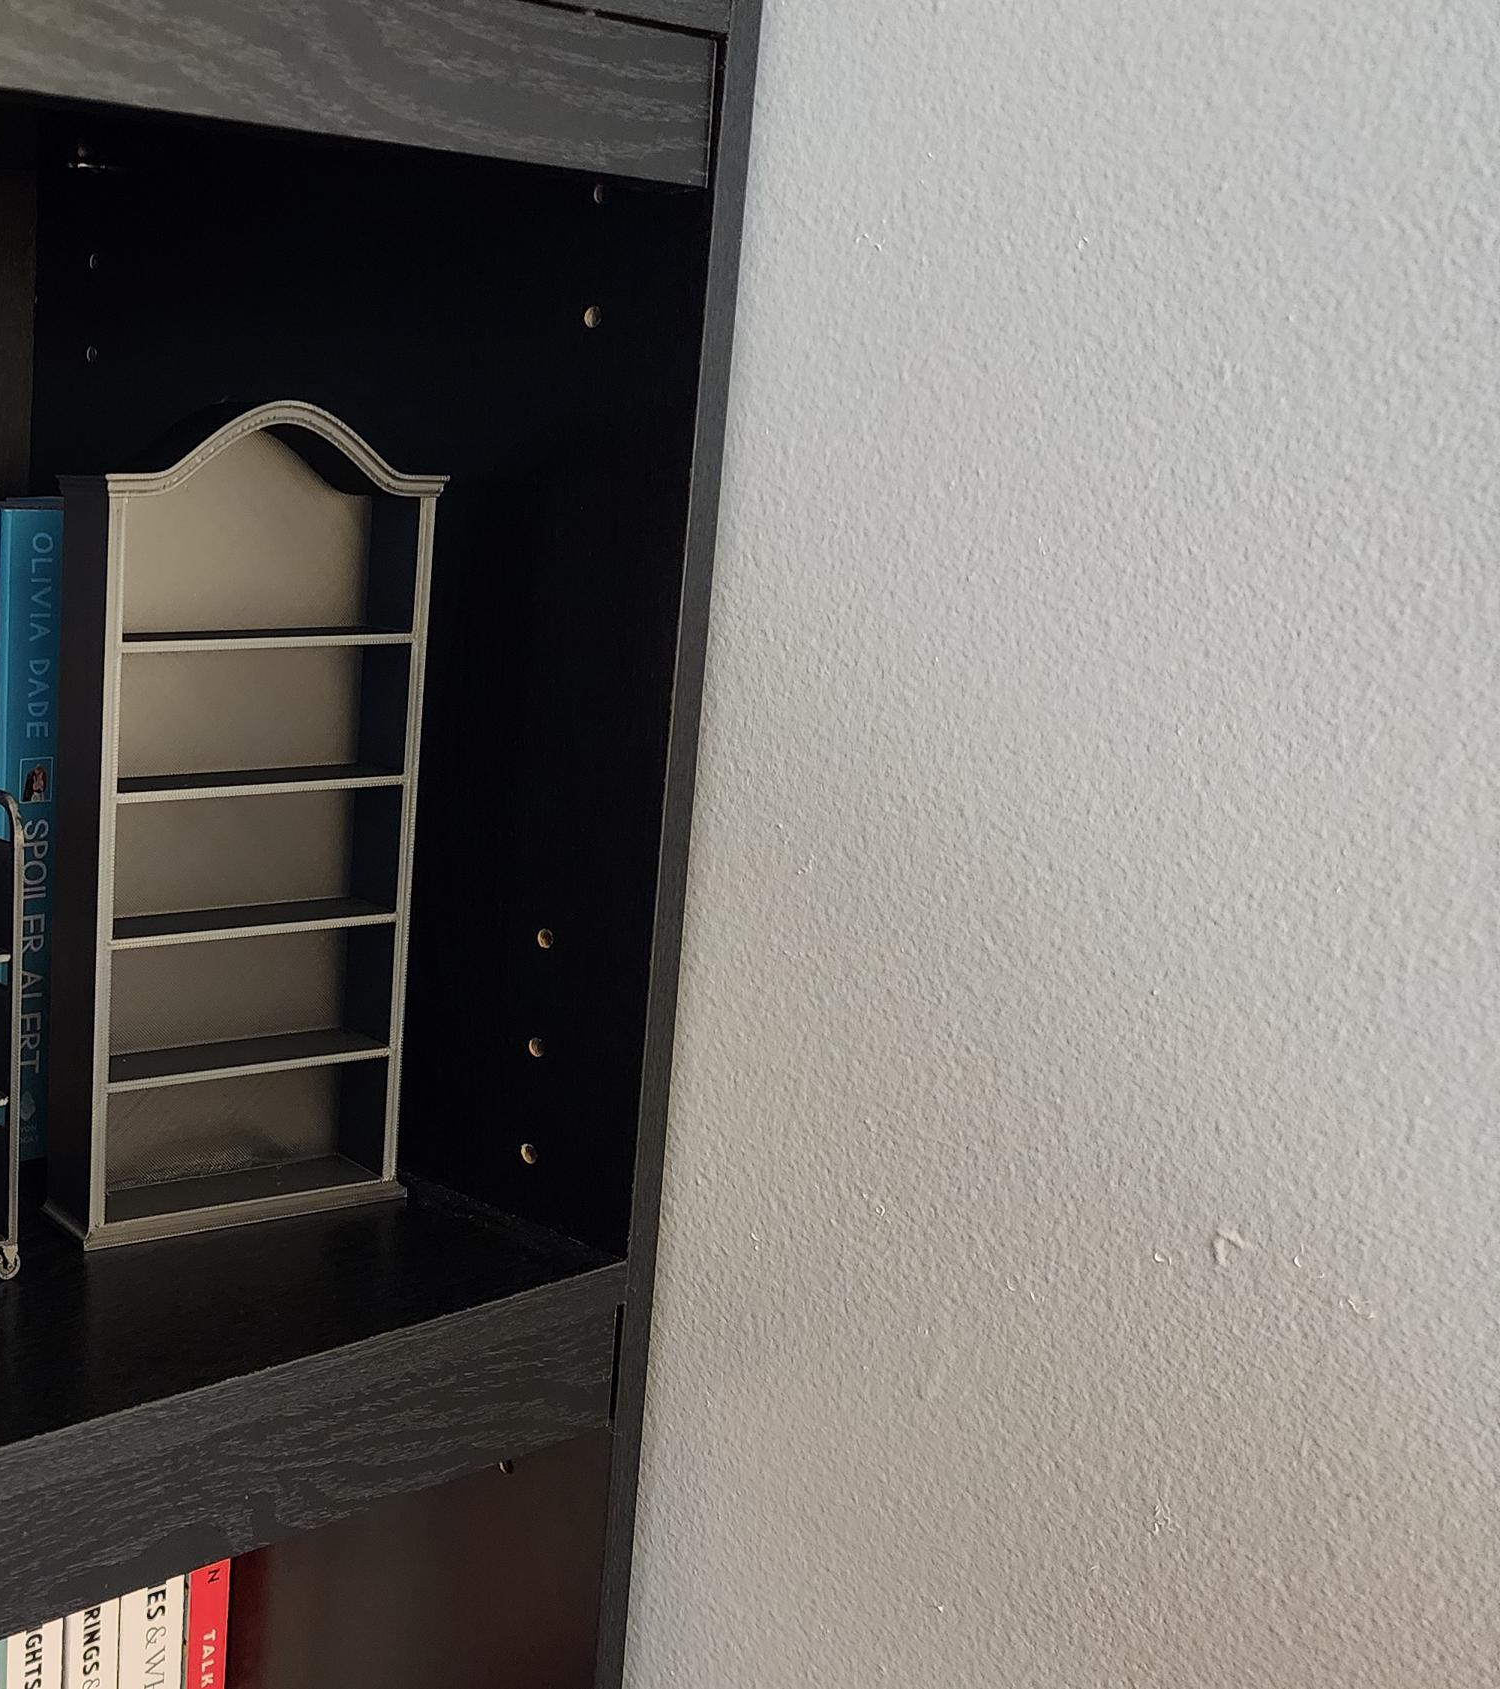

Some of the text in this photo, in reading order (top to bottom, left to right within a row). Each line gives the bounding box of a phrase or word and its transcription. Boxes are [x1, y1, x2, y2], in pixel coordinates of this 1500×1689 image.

[26, 532, 54, 739] OLIVIA DADE
[147, 1588, 166, 1620] ES
[25, 1633, 43, 1689] GHTS
